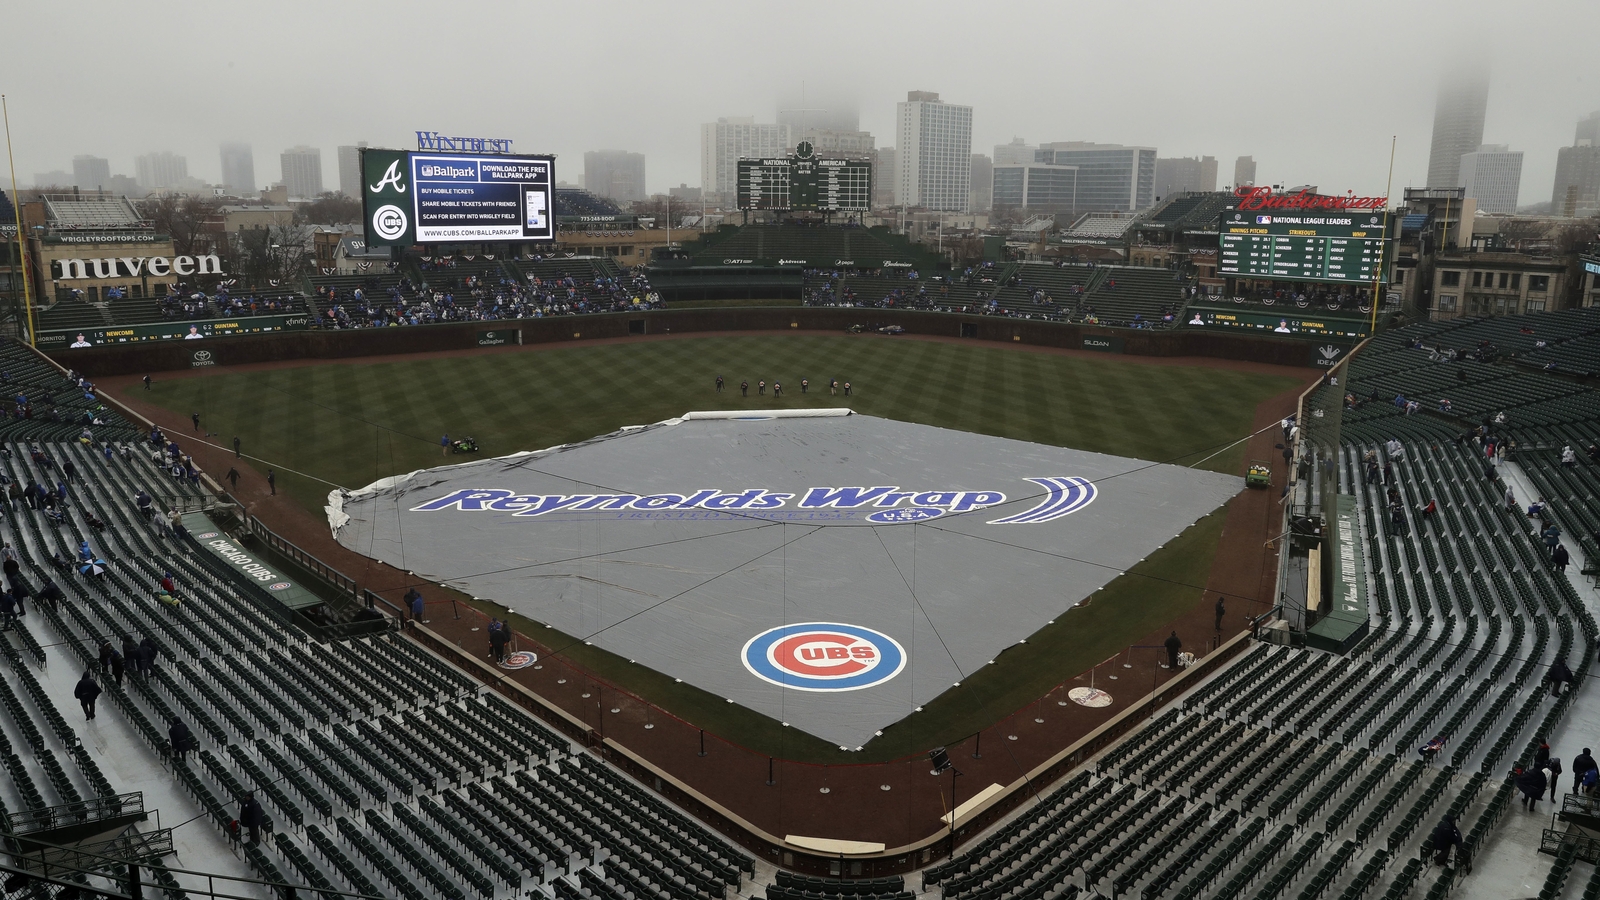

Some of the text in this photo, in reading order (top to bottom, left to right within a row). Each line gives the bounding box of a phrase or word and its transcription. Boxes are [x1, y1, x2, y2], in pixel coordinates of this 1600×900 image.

[415, 131, 513, 153] WINTRUST
[434, 166, 475, 178] Ballpark
[1234, 185, 1388, 211] Budweiser
[56, 254, 223, 280] nuveen
[286, 318, 308, 326] xfinity
[409, 486, 1007, 517] Reynolds Wrap
[209, 539, 276, 581] CHICAGO CUBS
[774, 634, 875, 676] CUBS
